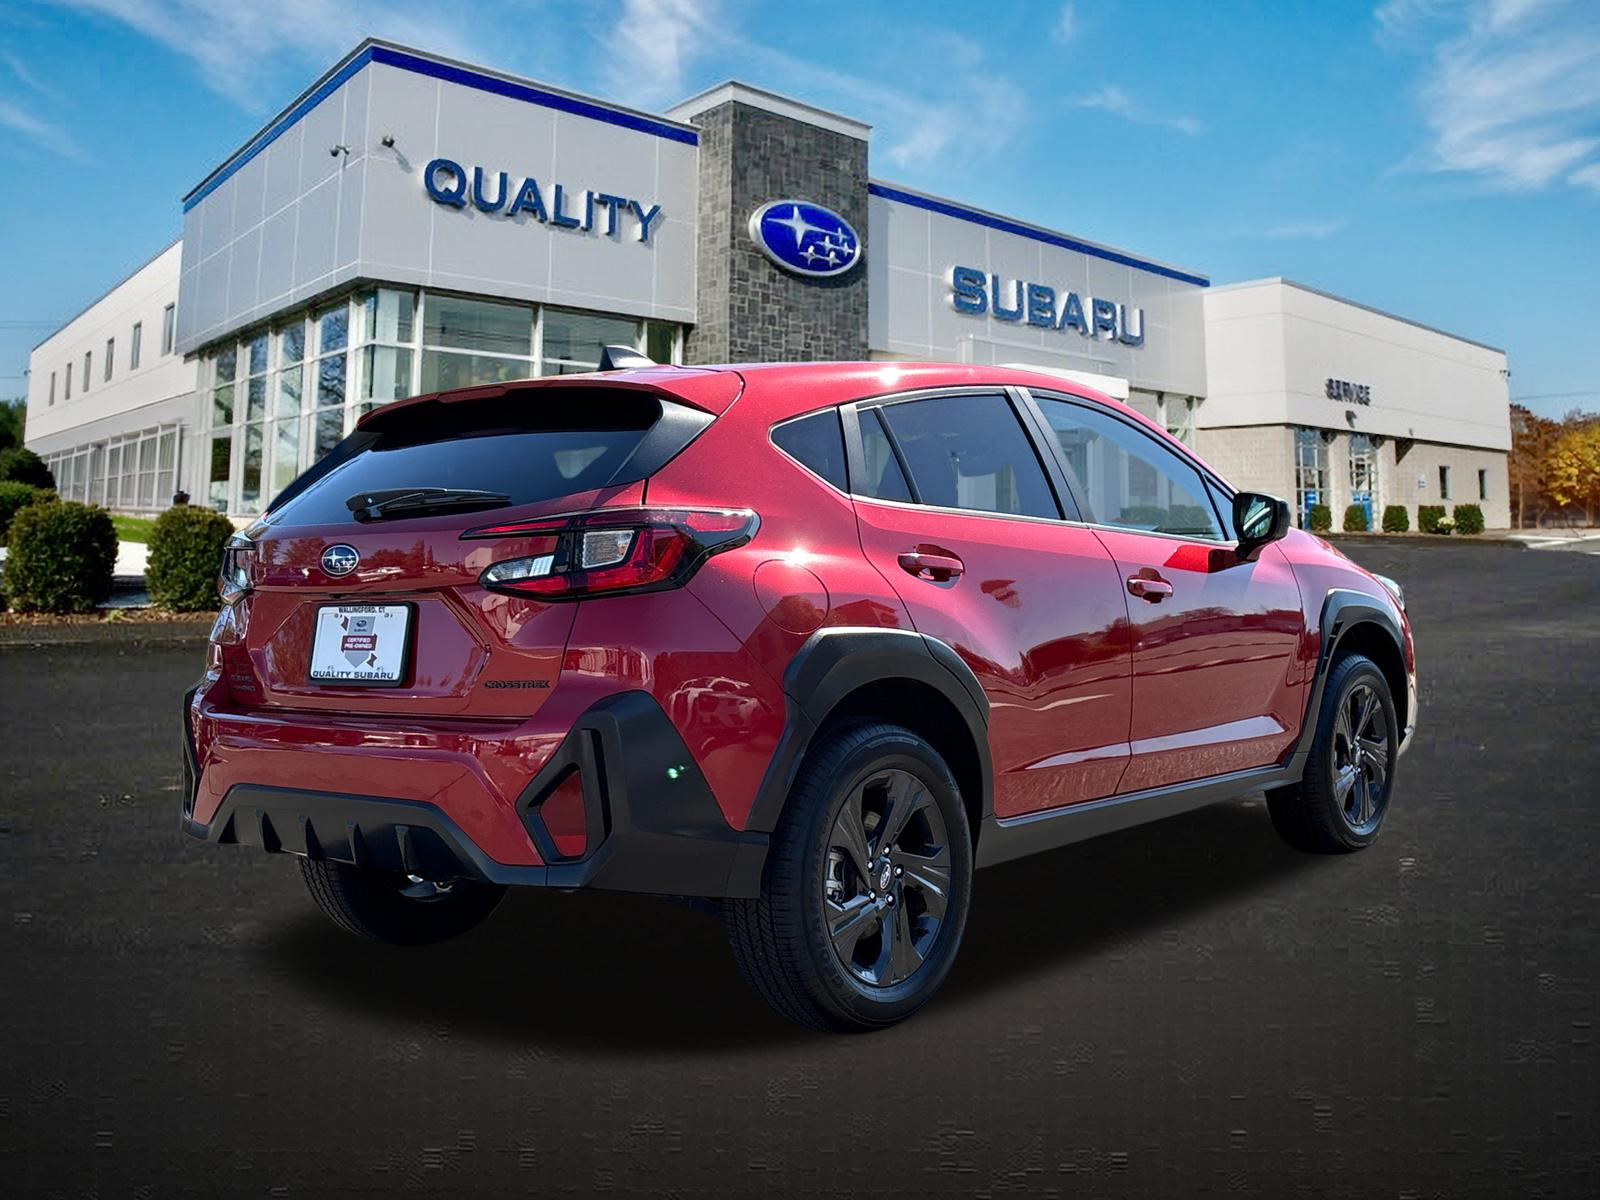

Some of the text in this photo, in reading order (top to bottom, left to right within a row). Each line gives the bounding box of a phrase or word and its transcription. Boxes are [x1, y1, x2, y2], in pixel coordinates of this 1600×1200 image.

[424, 158, 661, 243] QUALITY
[951, 265, 1145, 346] SUBARU
[1325, 378, 1371, 405] SERVICE
[312, 670, 394, 679] QUALITY SUBARU
[484, 680, 550, 689] CROSSTREK
